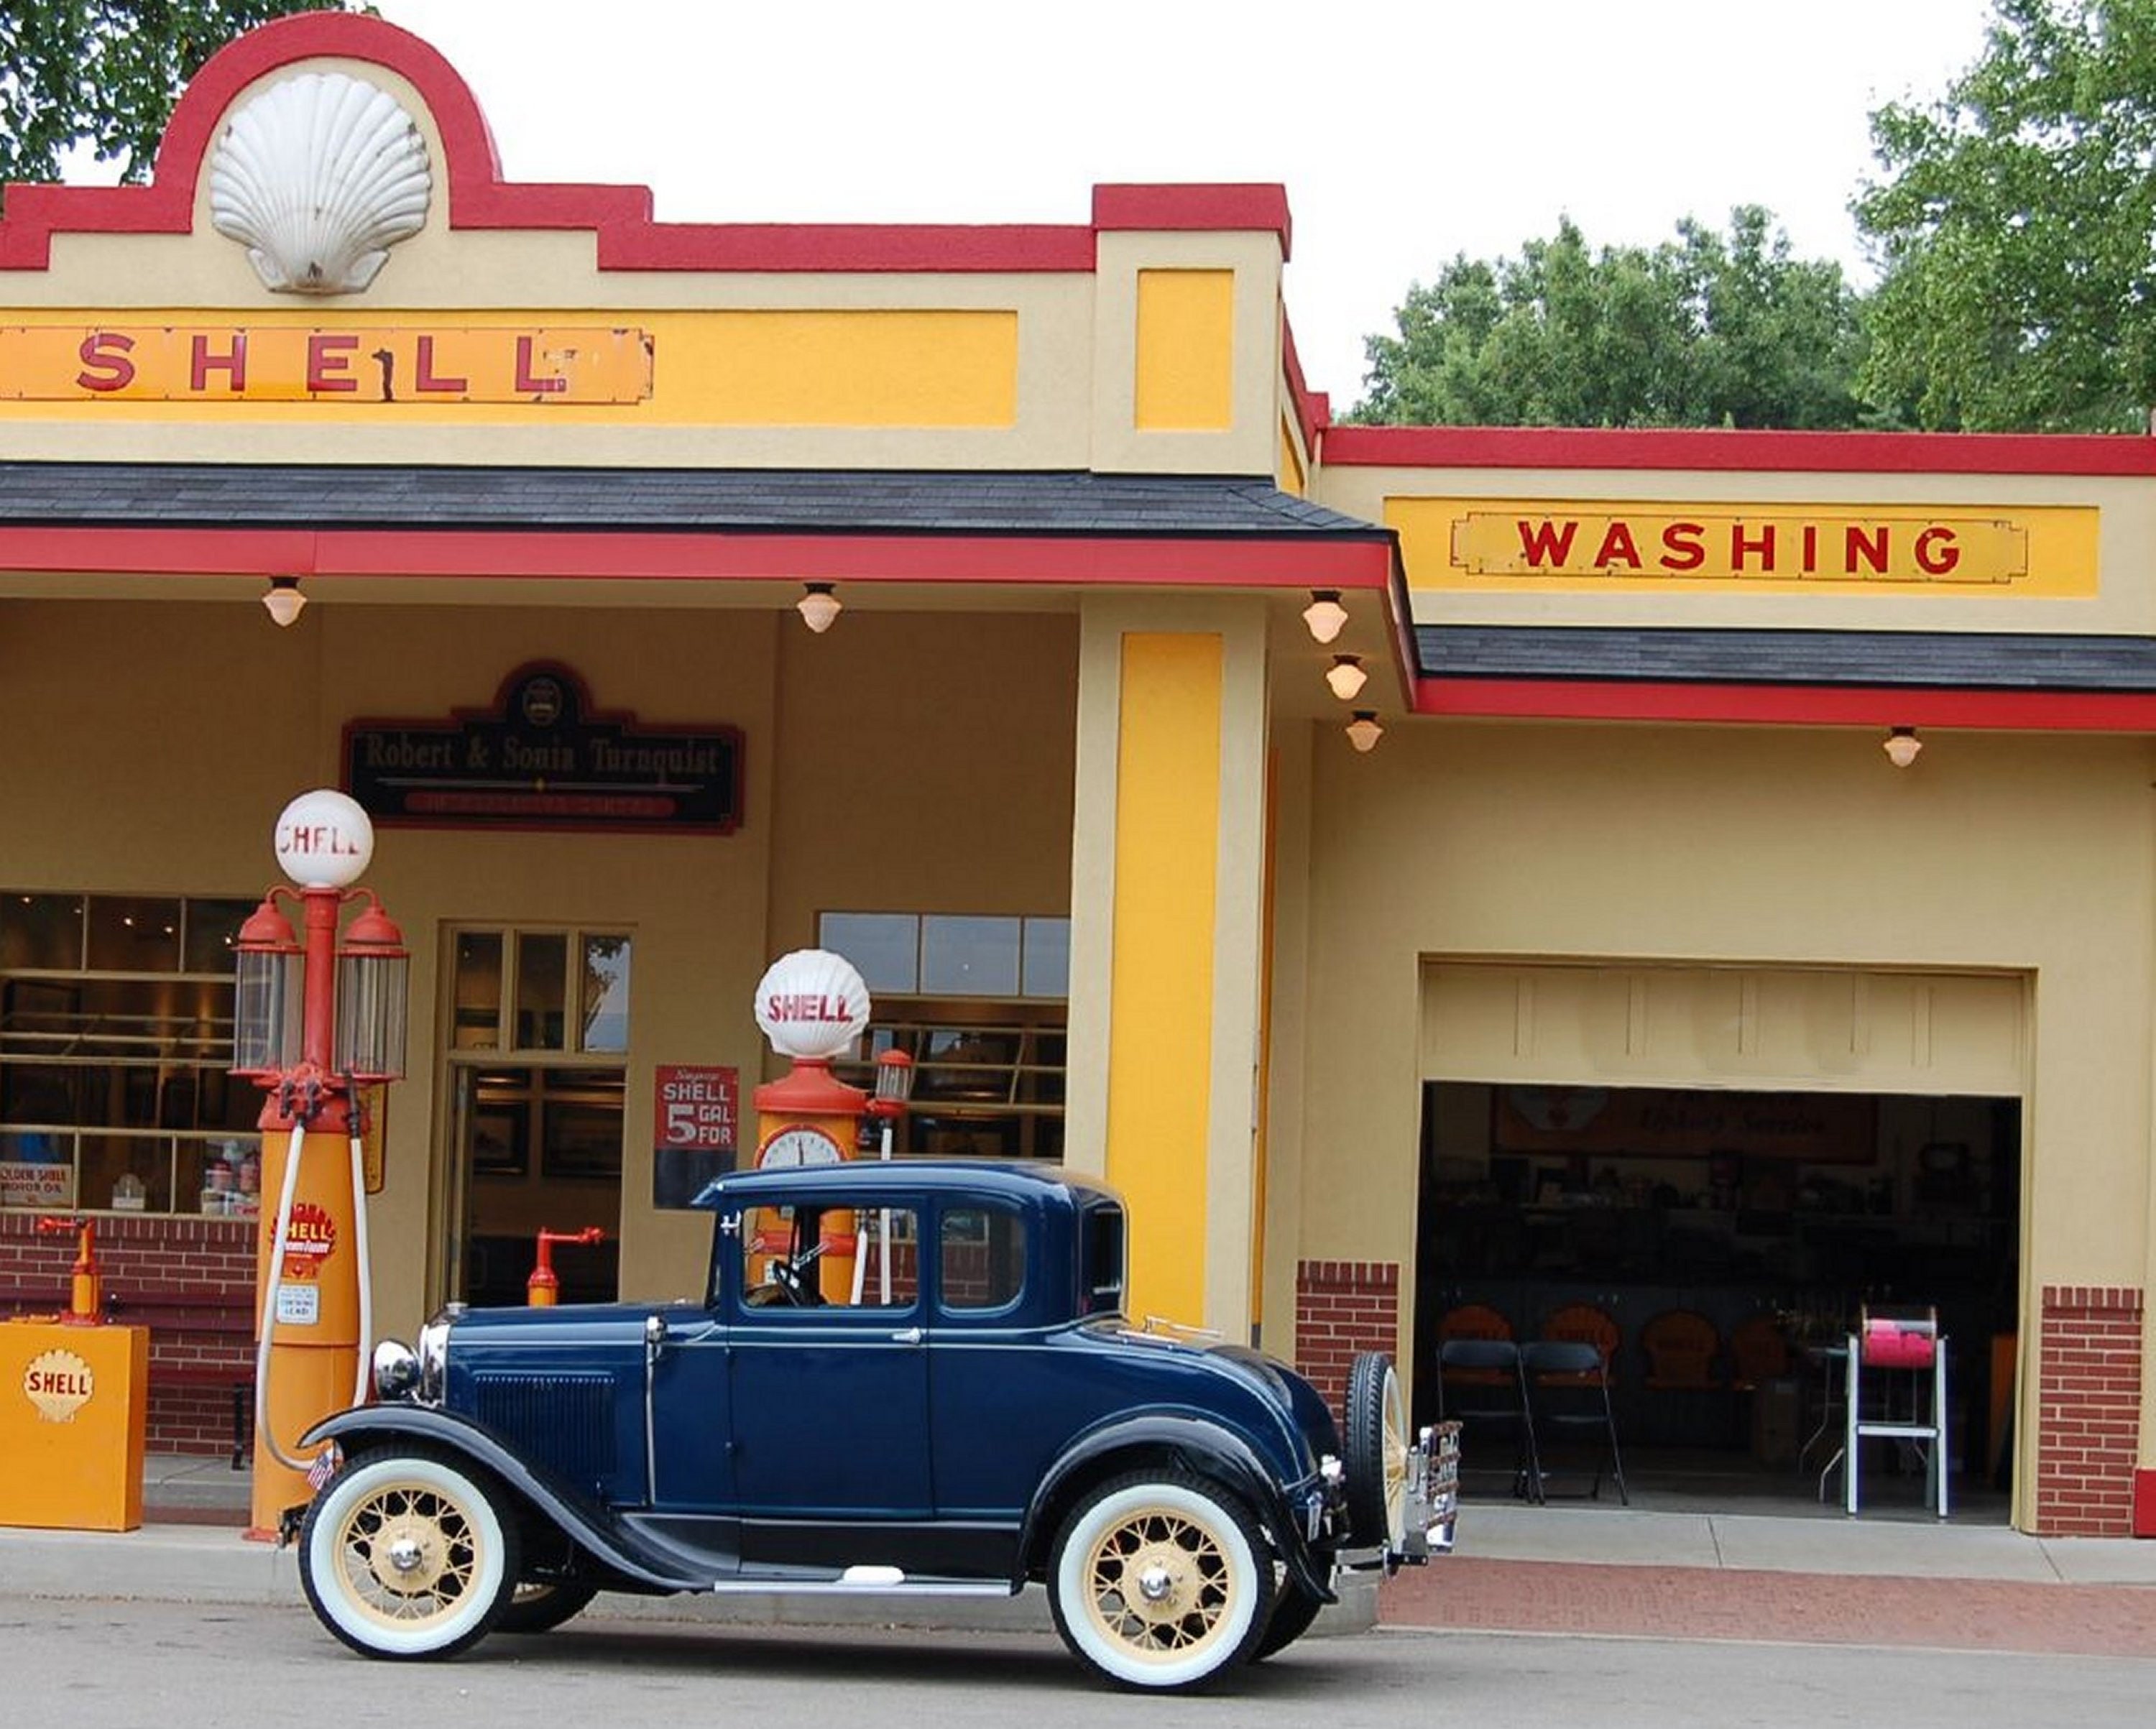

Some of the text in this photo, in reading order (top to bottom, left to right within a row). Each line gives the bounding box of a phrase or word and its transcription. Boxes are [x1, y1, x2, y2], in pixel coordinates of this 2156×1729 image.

[76, 332, 567, 392] SHELL
[1517, 521, 1960, 575] WASHING
[365, 734, 453, 768] Robert
[768, 995, 854, 1023] SHELL
[663, 1083, 730, 1102] SHELL
[667, 1103, 696, 1143] 5
[698, 1126, 732, 1145] FOR
[0, 1167, 34, 1181] OLDEN
[286, 1222, 328, 1240] HELL
[29, 1371, 88, 1396] SHELL
